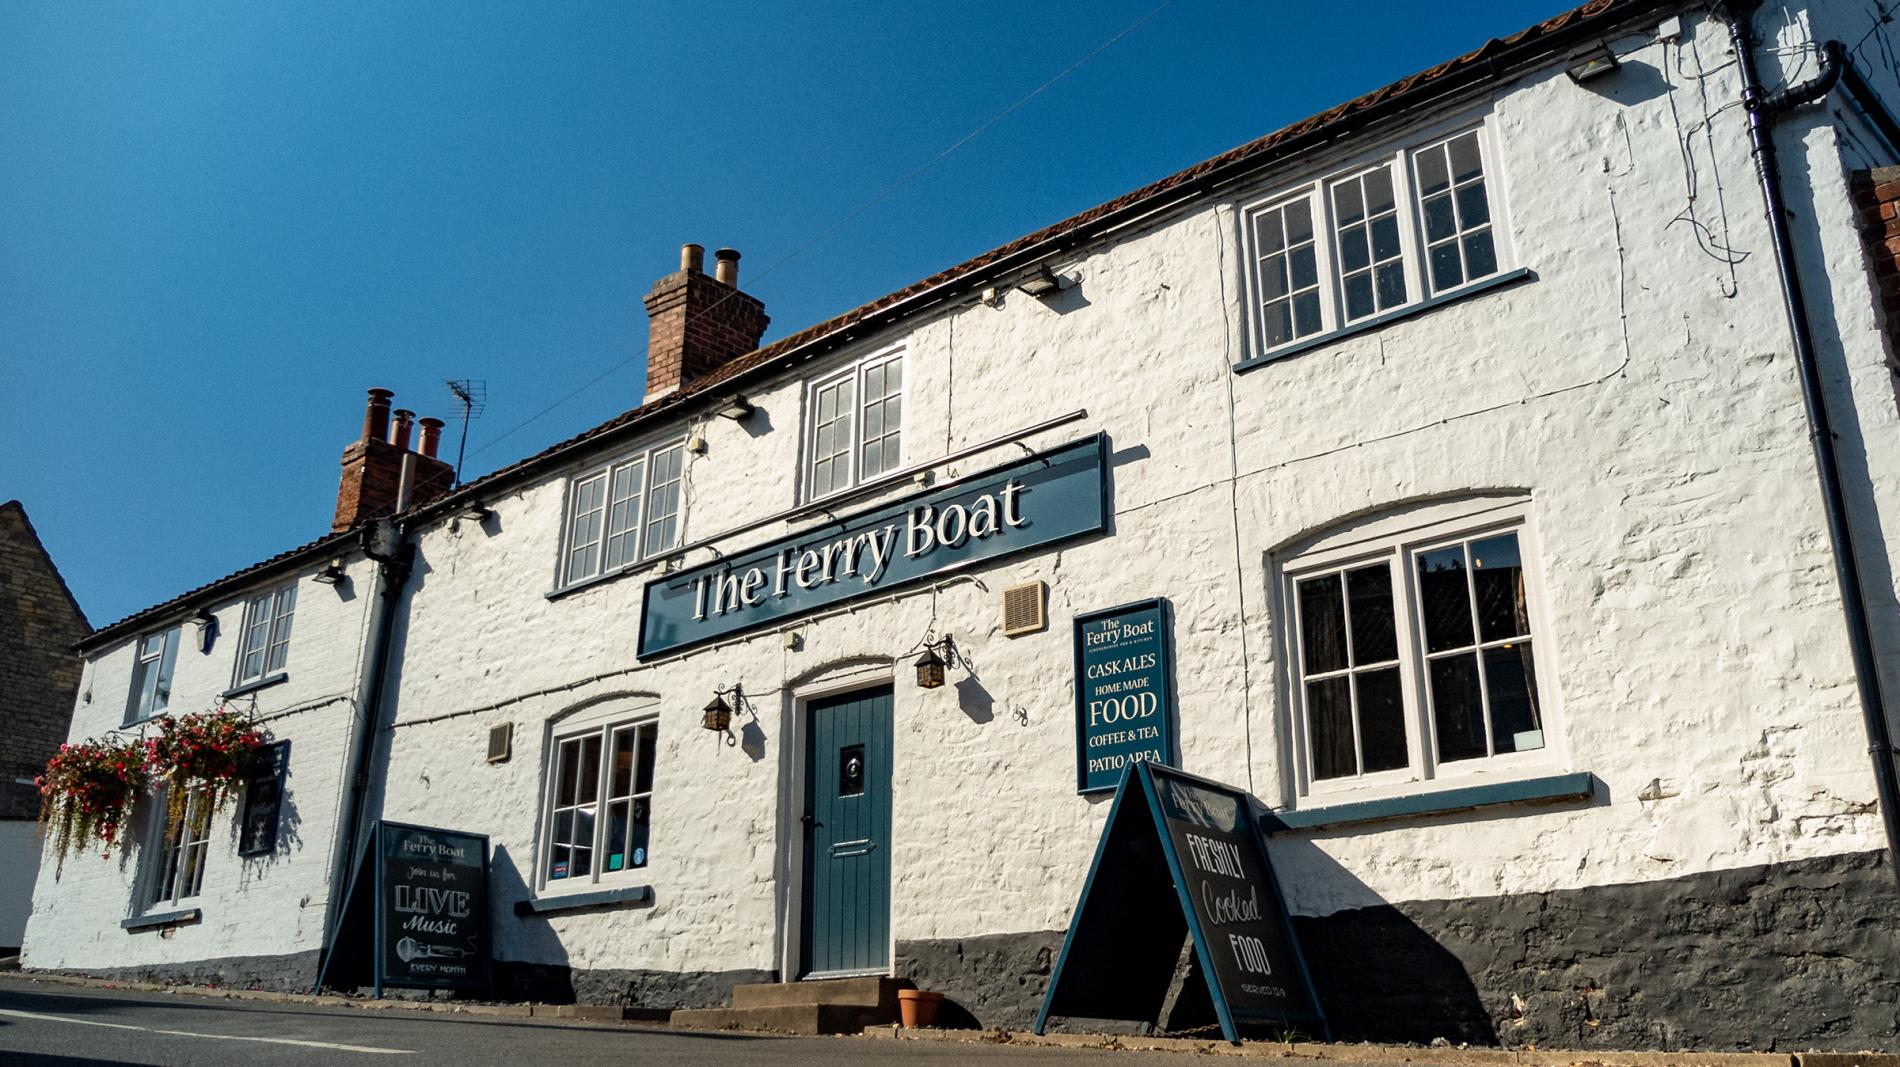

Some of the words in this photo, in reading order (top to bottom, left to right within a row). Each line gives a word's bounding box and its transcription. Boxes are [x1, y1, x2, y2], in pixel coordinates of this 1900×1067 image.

[688, 566, 764, 621] The
[772, 524, 895, 600] Ferry
[903, 476, 1025, 558] Boat
[1086, 629, 1121, 646] Ferry
[1123, 619, 1155, 638] Boat
[1101, 618, 1120, 631] The
[1087, 660, 1122, 679] CASK
[1123, 653, 1156, 671] ALES
[1095, 682, 1122, 696] HOME
[1122, 677, 1150, 691] MADE
[1088, 692, 1157, 727] FOOD
[1089, 731, 1127, 748] COFFEE
[1128, 730, 1136, 741] &
[1137, 726, 1159, 740] TEA
[1089, 754, 1125, 773] PATIO
[403, 840, 437, 857] Ferry
[438, 844, 465, 858] Boat
[418, 835, 436, 845] The
[1186, 833, 1245, 880] FRESHLY
[394, 884, 471, 918] LIVE
[1202, 880, 1262, 926] Cooked
[402, 915, 457, 935] Music
[1229, 933, 1272, 976] FOOD
[409, 963, 437, 973] EVERY
[439, 964, 467, 975] MONTH
